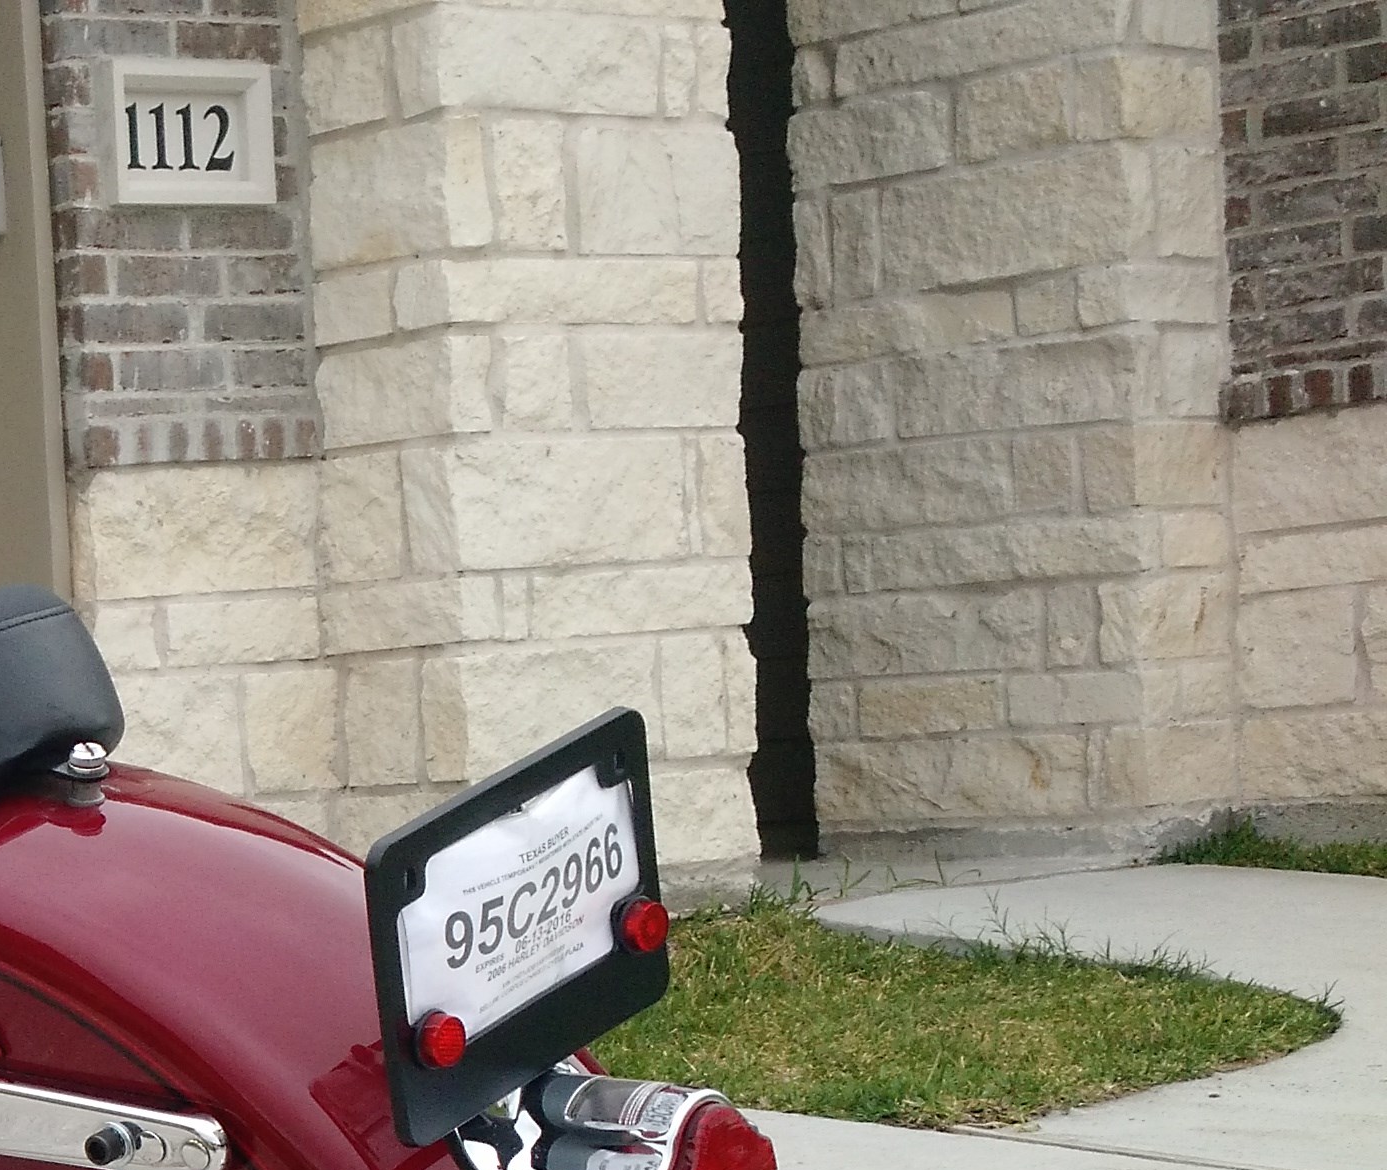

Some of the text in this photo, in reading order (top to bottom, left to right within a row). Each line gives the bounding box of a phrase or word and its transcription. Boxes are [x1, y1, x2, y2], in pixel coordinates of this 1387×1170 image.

[125, 102, 235, 172] 1112
[519, 842, 546, 864] TEXAS
[547, 826, 569, 849] BUYER
[444, 822, 623, 969] 95C2966
[515, 908, 572, 954] 06-13-2016
[508, 943, 540, 969] HARLEY
